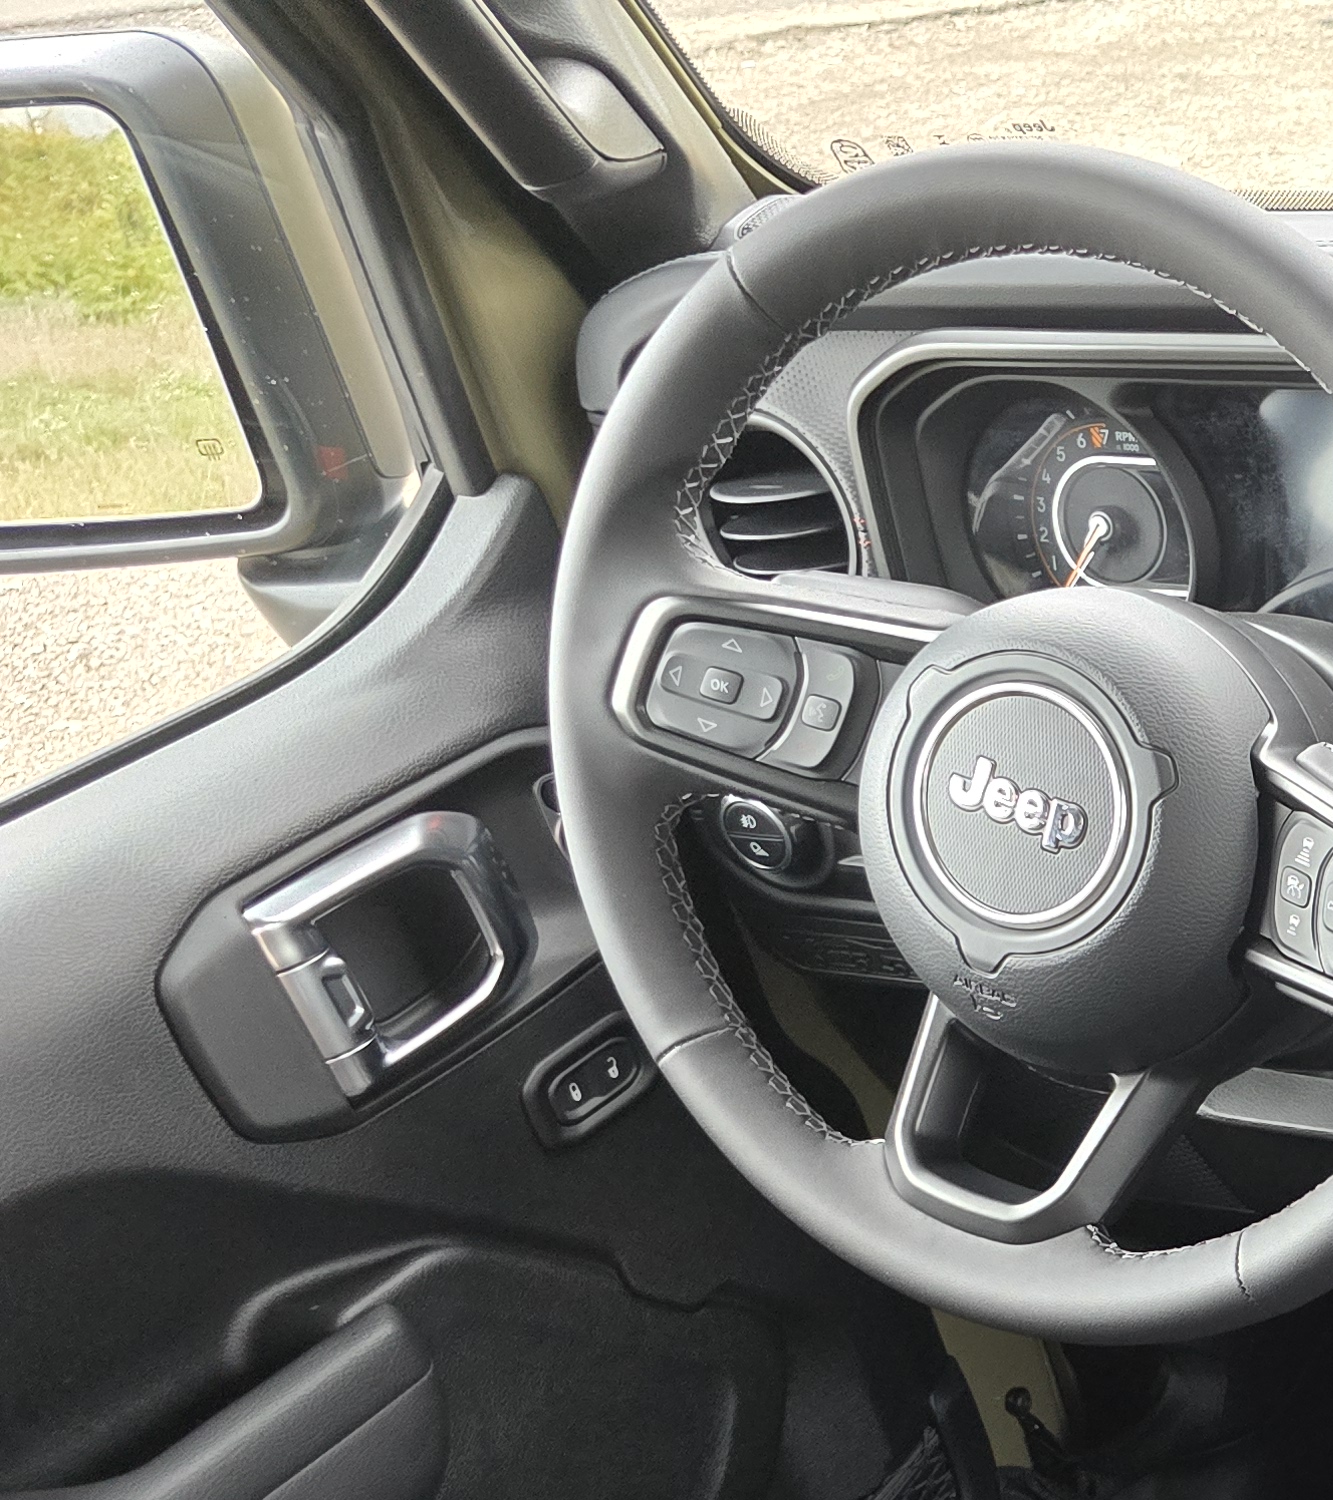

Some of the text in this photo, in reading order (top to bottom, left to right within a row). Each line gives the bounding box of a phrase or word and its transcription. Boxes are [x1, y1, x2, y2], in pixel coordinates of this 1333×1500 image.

[1076, 434, 1086, 448] 6
[1101, 429, 1109, 445] 7
[1056, 447, 1065, 461] 5
[1042, 469, 1051, 483] 4
[1037, 497, 1046, 512] 3
[1039, 527, 1049, 542] 2
[1052, 555, 1057, 571] 1
[710, 679, 729, 693] OK
[948, 755, 1088, 854] Jeep
